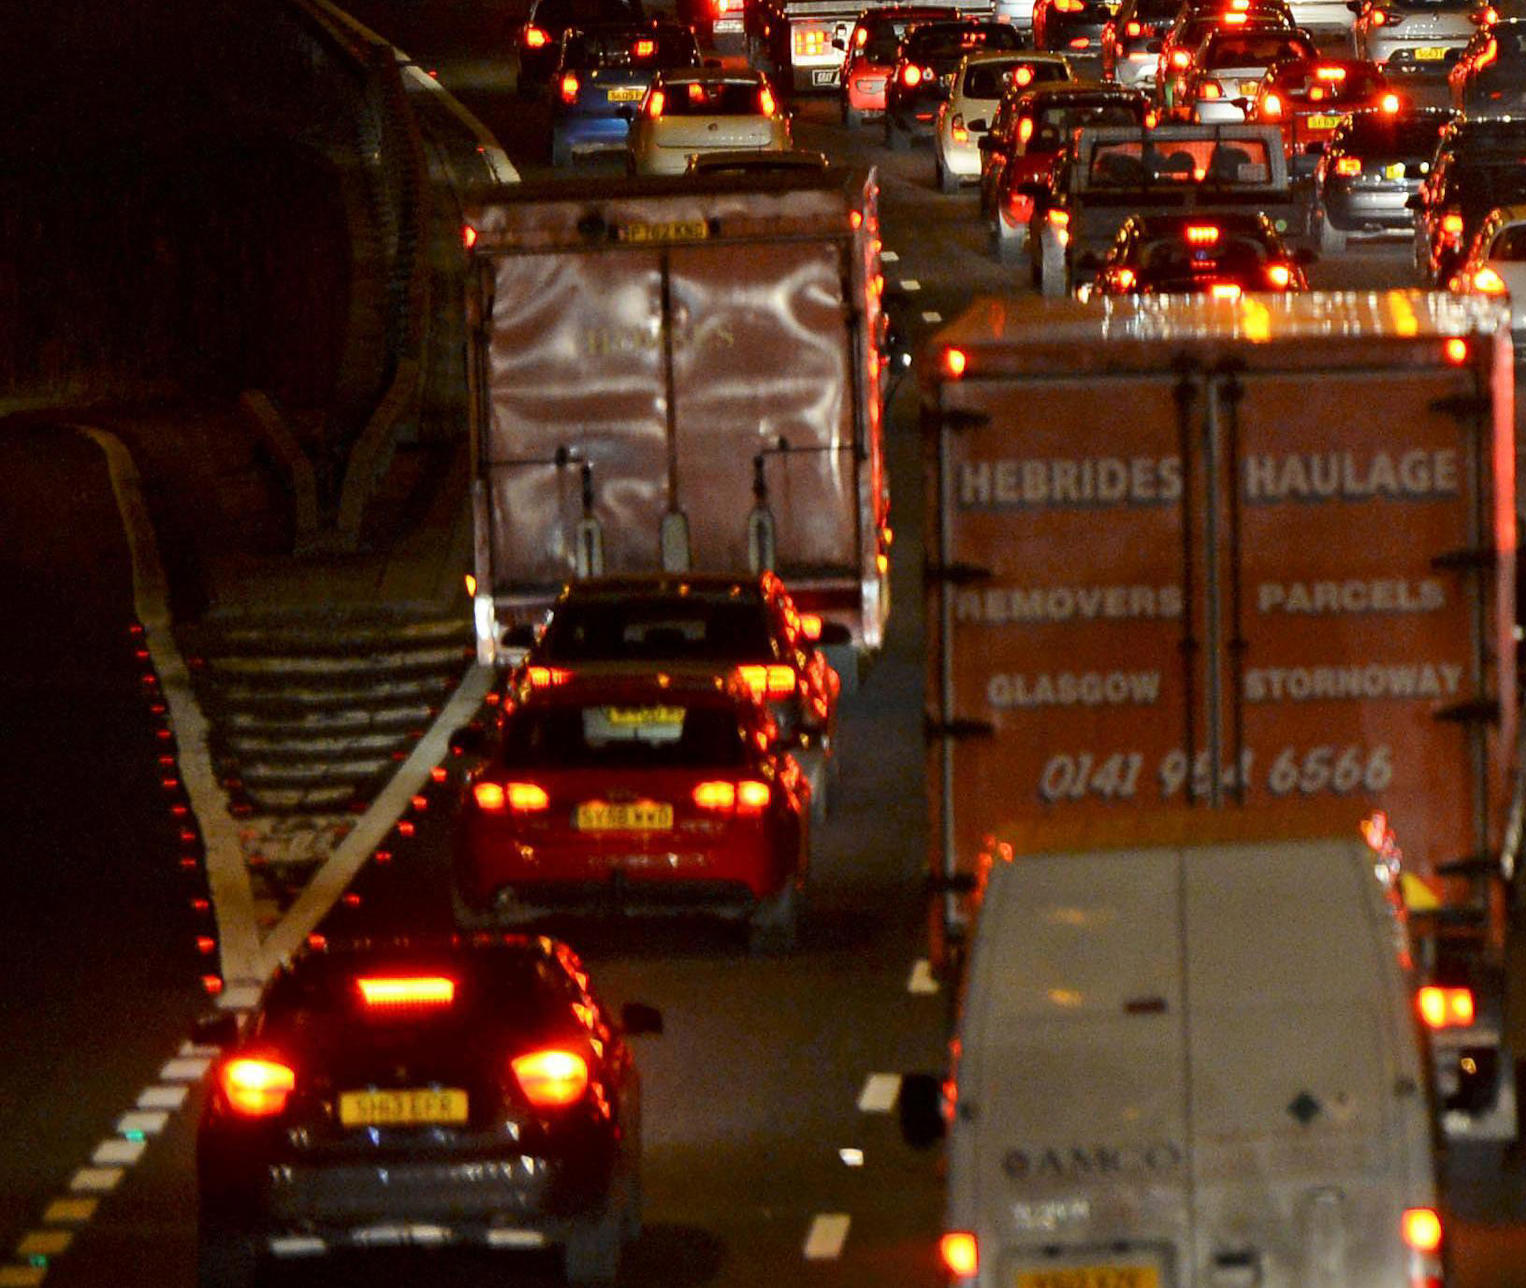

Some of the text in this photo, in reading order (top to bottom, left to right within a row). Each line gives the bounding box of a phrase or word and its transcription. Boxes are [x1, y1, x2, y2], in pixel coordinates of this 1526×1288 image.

[958, 449, 1458, 503] HEBRIDES HAULAGE
[956, 578, 1446, 620] REMOVERS PARCELS
[987, 663, 1464, 706] GLASGOW STORNOWAY
[1039, 752, 1143, 800] 0141
[1268, 745, 1394, 792] 6566
